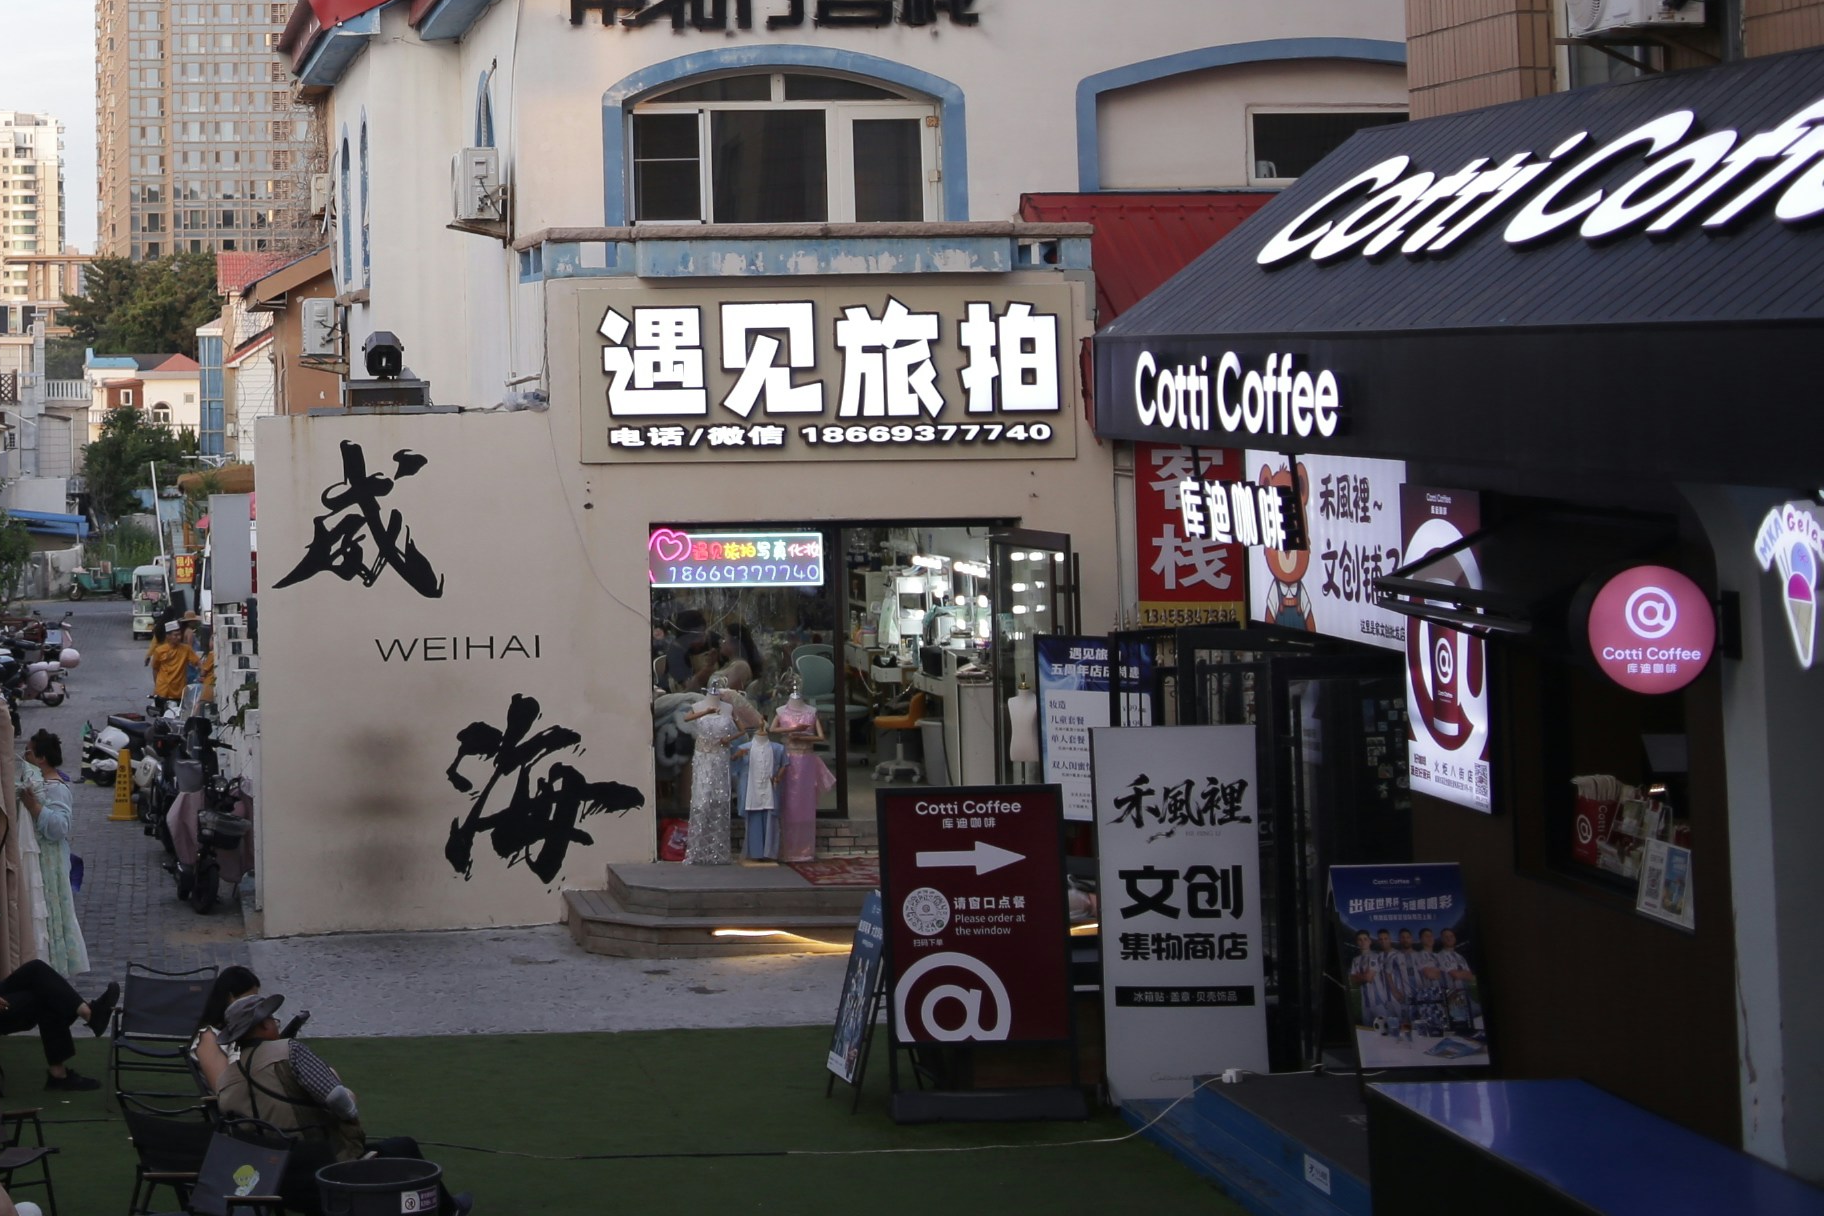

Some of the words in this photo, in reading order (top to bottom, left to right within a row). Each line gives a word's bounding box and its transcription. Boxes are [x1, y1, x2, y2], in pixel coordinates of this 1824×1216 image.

[1257, 132, 1588, 265] Cotti
[597, 295, 1060, 418] 遇见旅拍
[1135, 351, 1209, 431] Cotti
[1217, 351, 1340, 437] Coffee
[608, 425, 785, 447] 电话/微信
[800, 423, 1052, 444] 18669377740
[1179, 476, 1286, 552] 库迪咖啡
[692, 540, 821, 561] 遇见旅拍写真化妆
[669, 564, 819, 582] 18669377740
[375, 634, 541, 662] WEIHAI
[1069, 647, 1121, 662] 遇见旅
[1602, 646, 1642, 660] Cotti
[1647, 646, 1701, 660] Coffee
[1627, 663, 1677, 674] 库迪咖啡
[915, 801, 958, 815] Cotti
[962, 800, 1022, 814] Coffee
[942, 817, 997, 829] 库迪咖啡
[1118, 865, 1243, 919] 文创
[954, 896, 1026, 910] 请窗口点餐
[955, 914, 986, 923] Please
[987, 914, 1013, 923] order
[1016, 914, 1026, 922] at
[955, 927, 972, 936] the
[973, 926, 1011, 935] window
[913, 939, 944, 948] 扫码下单
[1119, 932, 1248, 961] 集物商店
